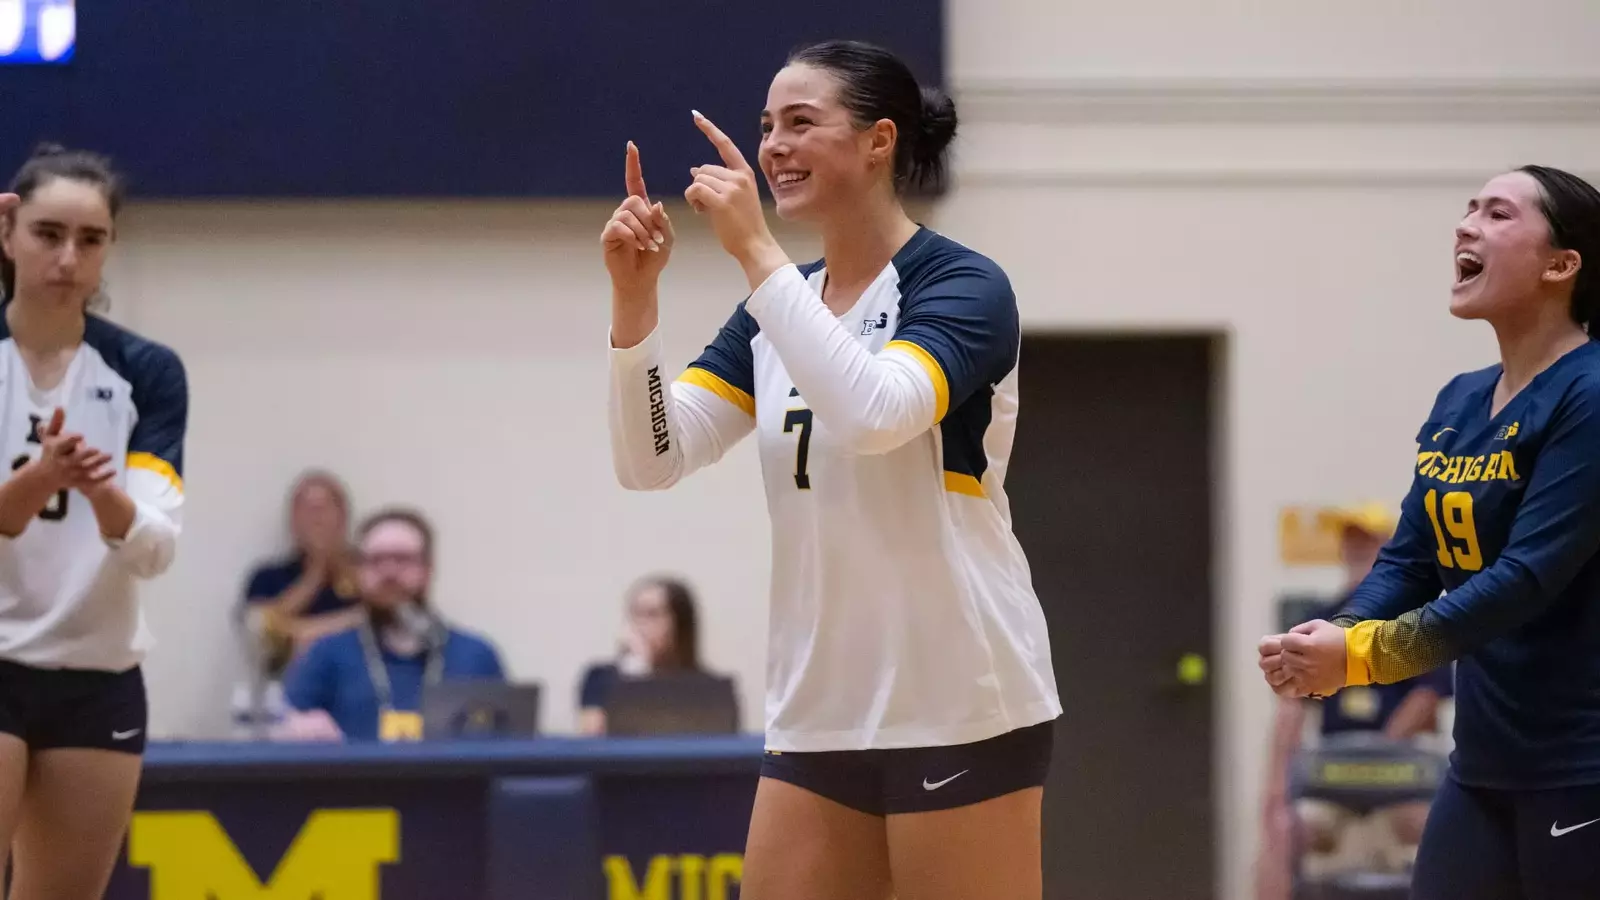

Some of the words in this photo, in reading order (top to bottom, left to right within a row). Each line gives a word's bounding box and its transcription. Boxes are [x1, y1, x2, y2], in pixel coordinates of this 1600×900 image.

[647, 364, 670, 457] MICHIGAN
[782, 407, 813, 490] 7
[1424, 488, 1483, 571] 19
[129, 807, 400, 900] M
